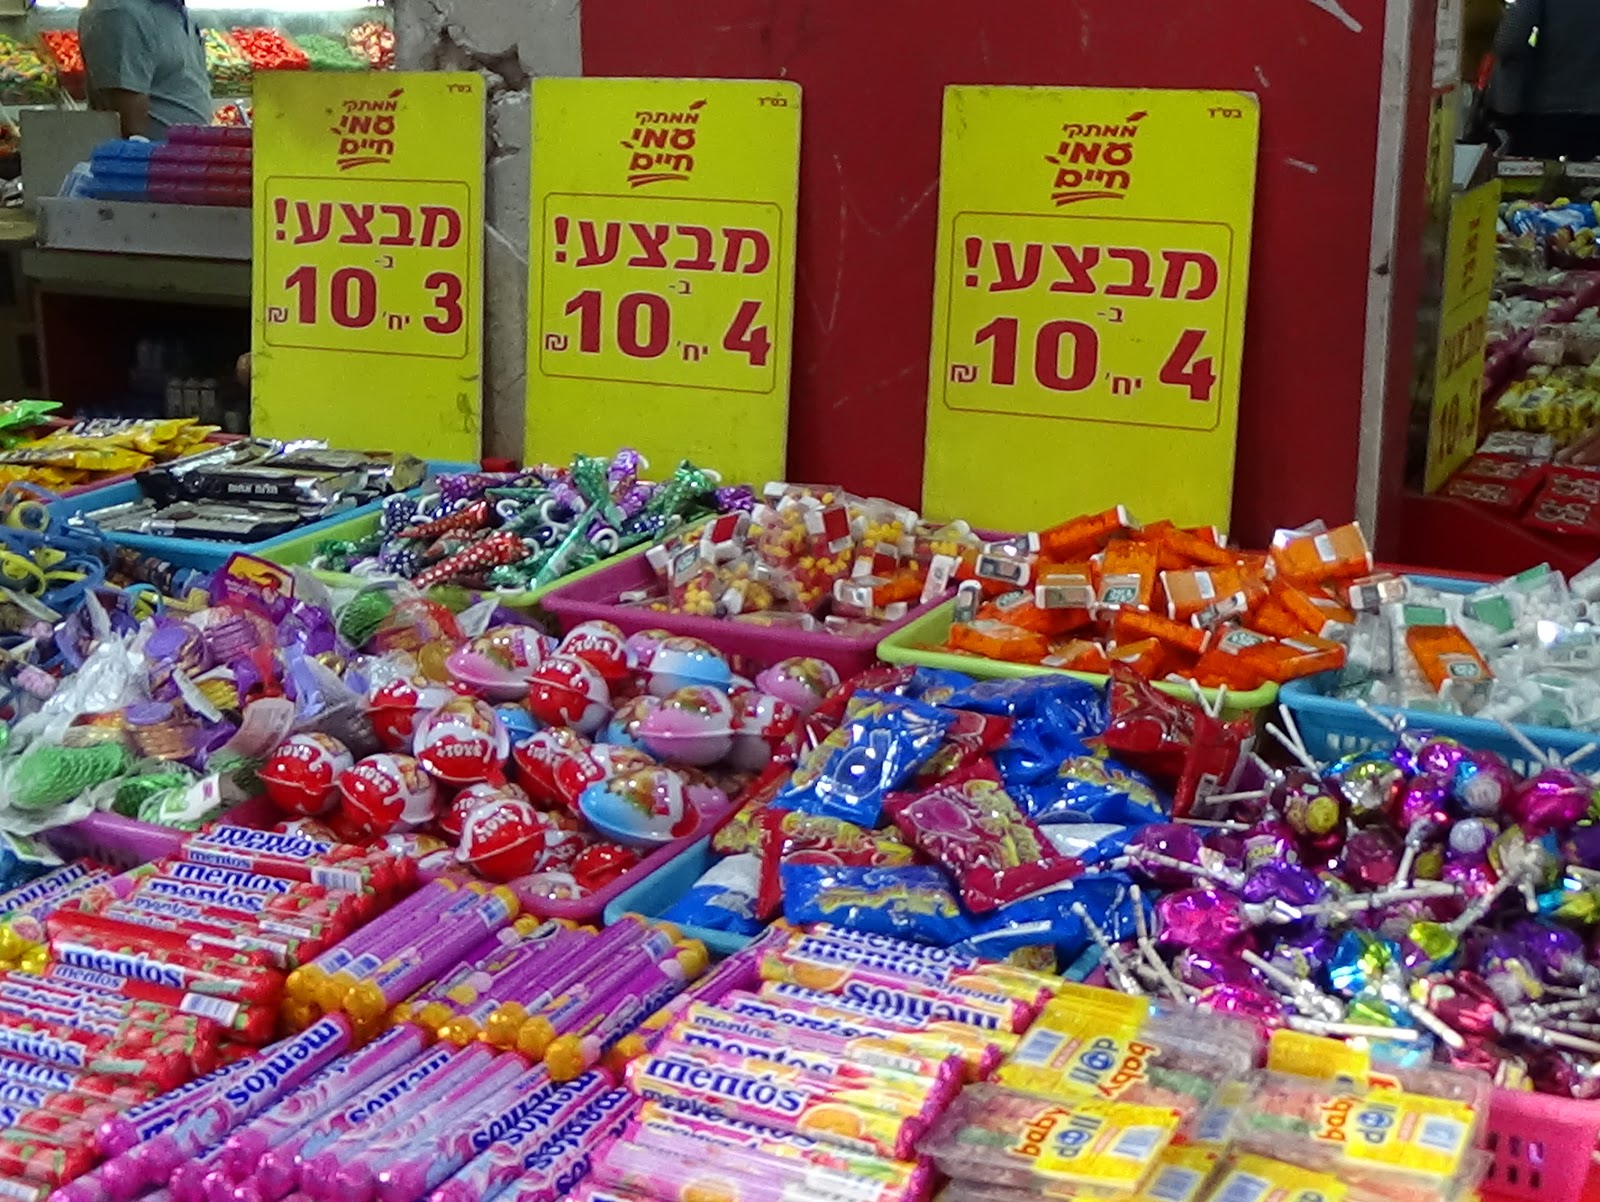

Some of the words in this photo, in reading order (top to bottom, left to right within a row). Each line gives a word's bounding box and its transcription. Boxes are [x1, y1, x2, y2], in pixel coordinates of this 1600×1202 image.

[342, 99, 398, 113] ממתקי
[635, 111, 700, 125] ממתקי
[1062, 123, 1139, 138] ממתקי
[338, 138, 394, 156] חיים
[628, 153, 694, 172] חיים
[1053, 168, 1131, 190] חיים
[274, 198, 462, 248] מבצע!
[553, 216, 771, 275] מבצע!
[964, 236, 1219, 301] מבצע!
[284, 265, 377, 329] 10
[423, 271, 464, 334] 3
[564, 290, 671, 358] 10
[722, 300, 772, 366] 4
[974, 316, 1099, 392] 10
[1158, 328, 1217, 401] 4
[173, 862, 293, 895] mentos
[55, 966, 120, 989] mentos
[64, 950, 183, 989] mentos
[0, 1030, 82, 1067] entos
[225, 1021, 340, 1108] mentos
[1097, 1041, 1157, 1097] baby
[646, 1059, 804, 1112] mentos
